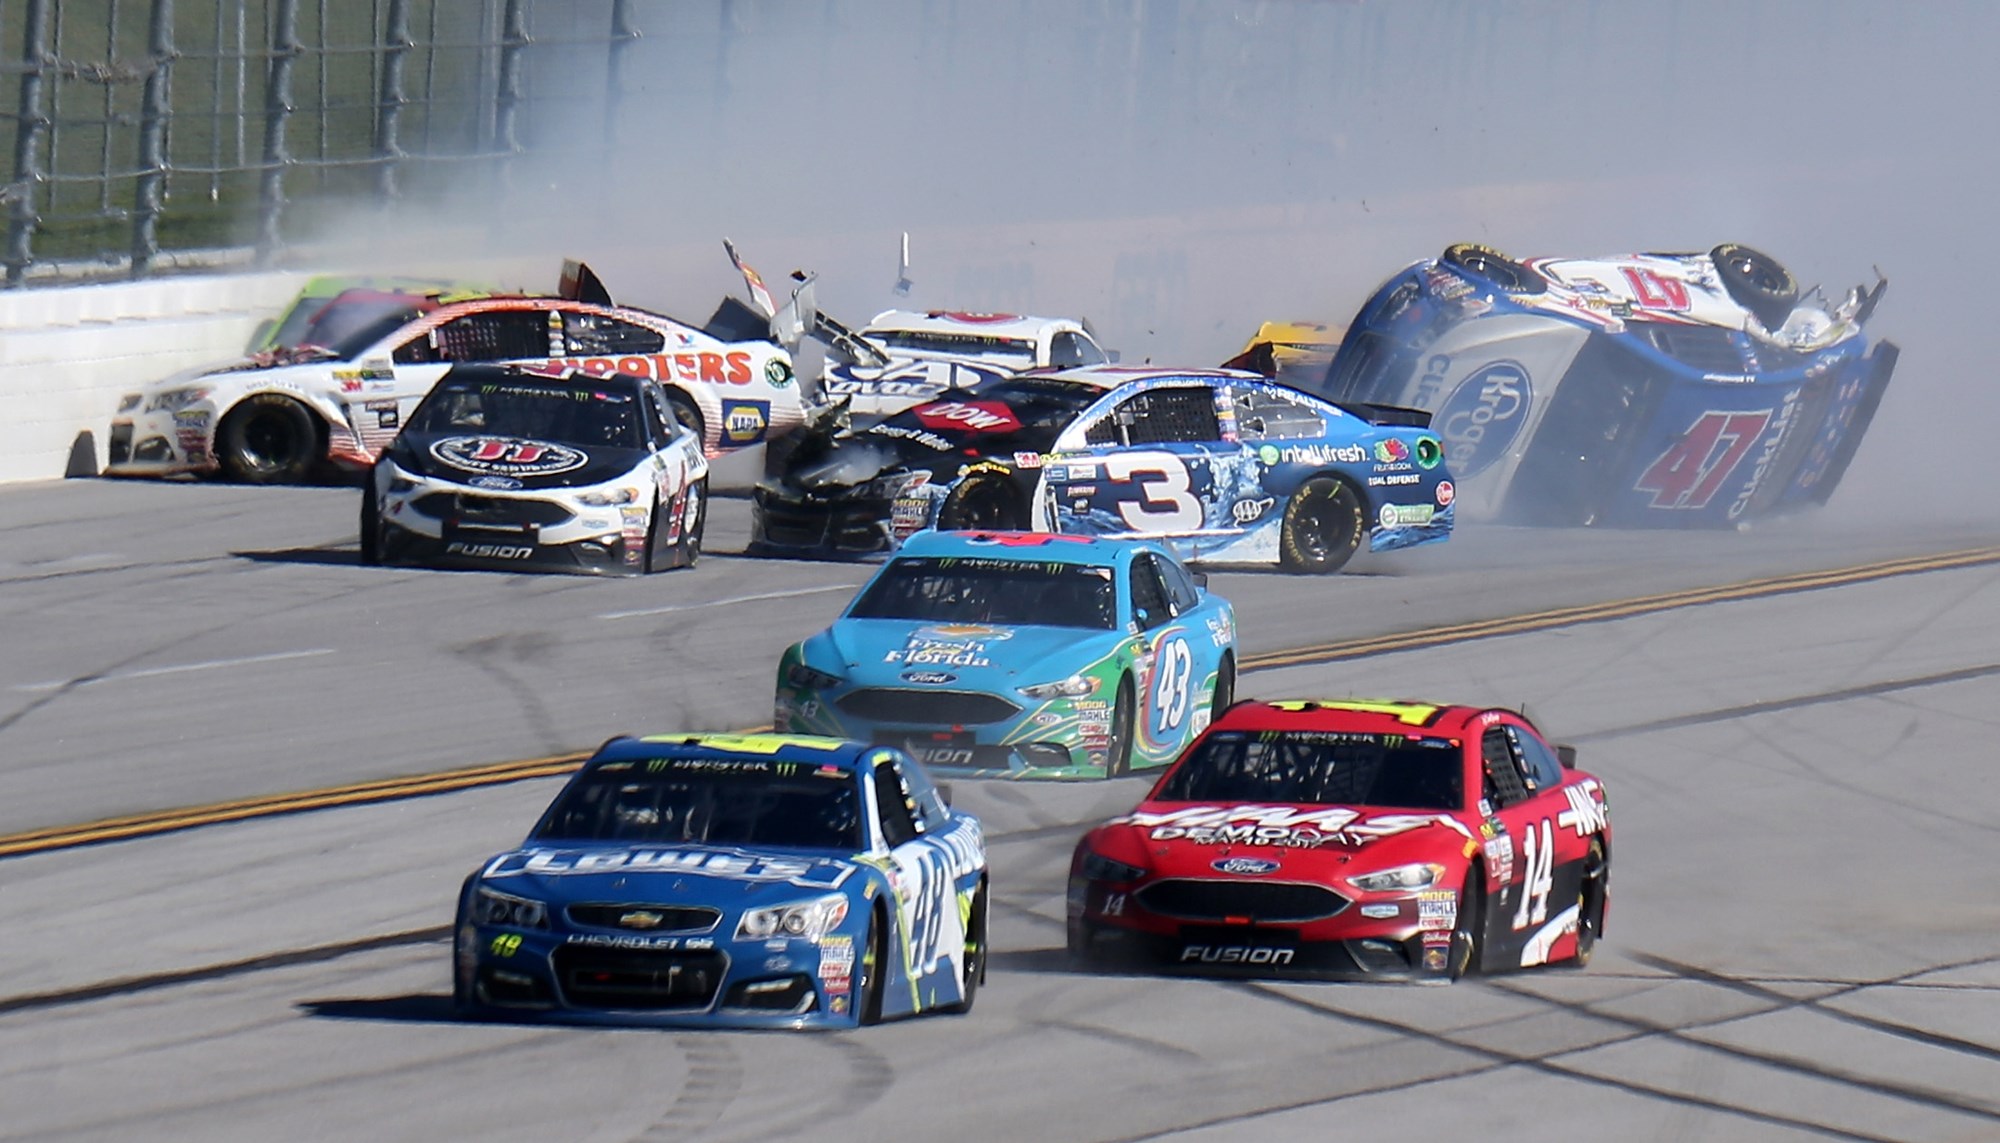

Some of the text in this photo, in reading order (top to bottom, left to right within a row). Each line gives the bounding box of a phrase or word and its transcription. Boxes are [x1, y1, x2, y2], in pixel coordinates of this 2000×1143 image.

[1412, 353, 1450, 408] Clic
[731, 415, 758, 432] NAPA
[921, 402, 1011, 429] DOW
[1444, 375, 1521, 474] Kroger
[1633, 408, 1773, 510] 47
[1104, 451, 1204, 534] 3
[1234, 500, 1260, 520] AAA
[447, 542, 533, 560] FUSION
[906, 638, 986, 653] Fresh
[882, 650, 991, 668] Florida
[908, 672, 947, 684] Ford
[1157, 637, 1192, 732] 43
[1285, 731, 1376, 743] MONSTER
[1223, 858, 1269, 874] Ford
[1511, 816, 1554, 931] 14
[1101, 894, 1127, 916] 14
[567, 933, 715, 950] CHEVROLET SS
[1180, 945, 1295, 965] FUSION
